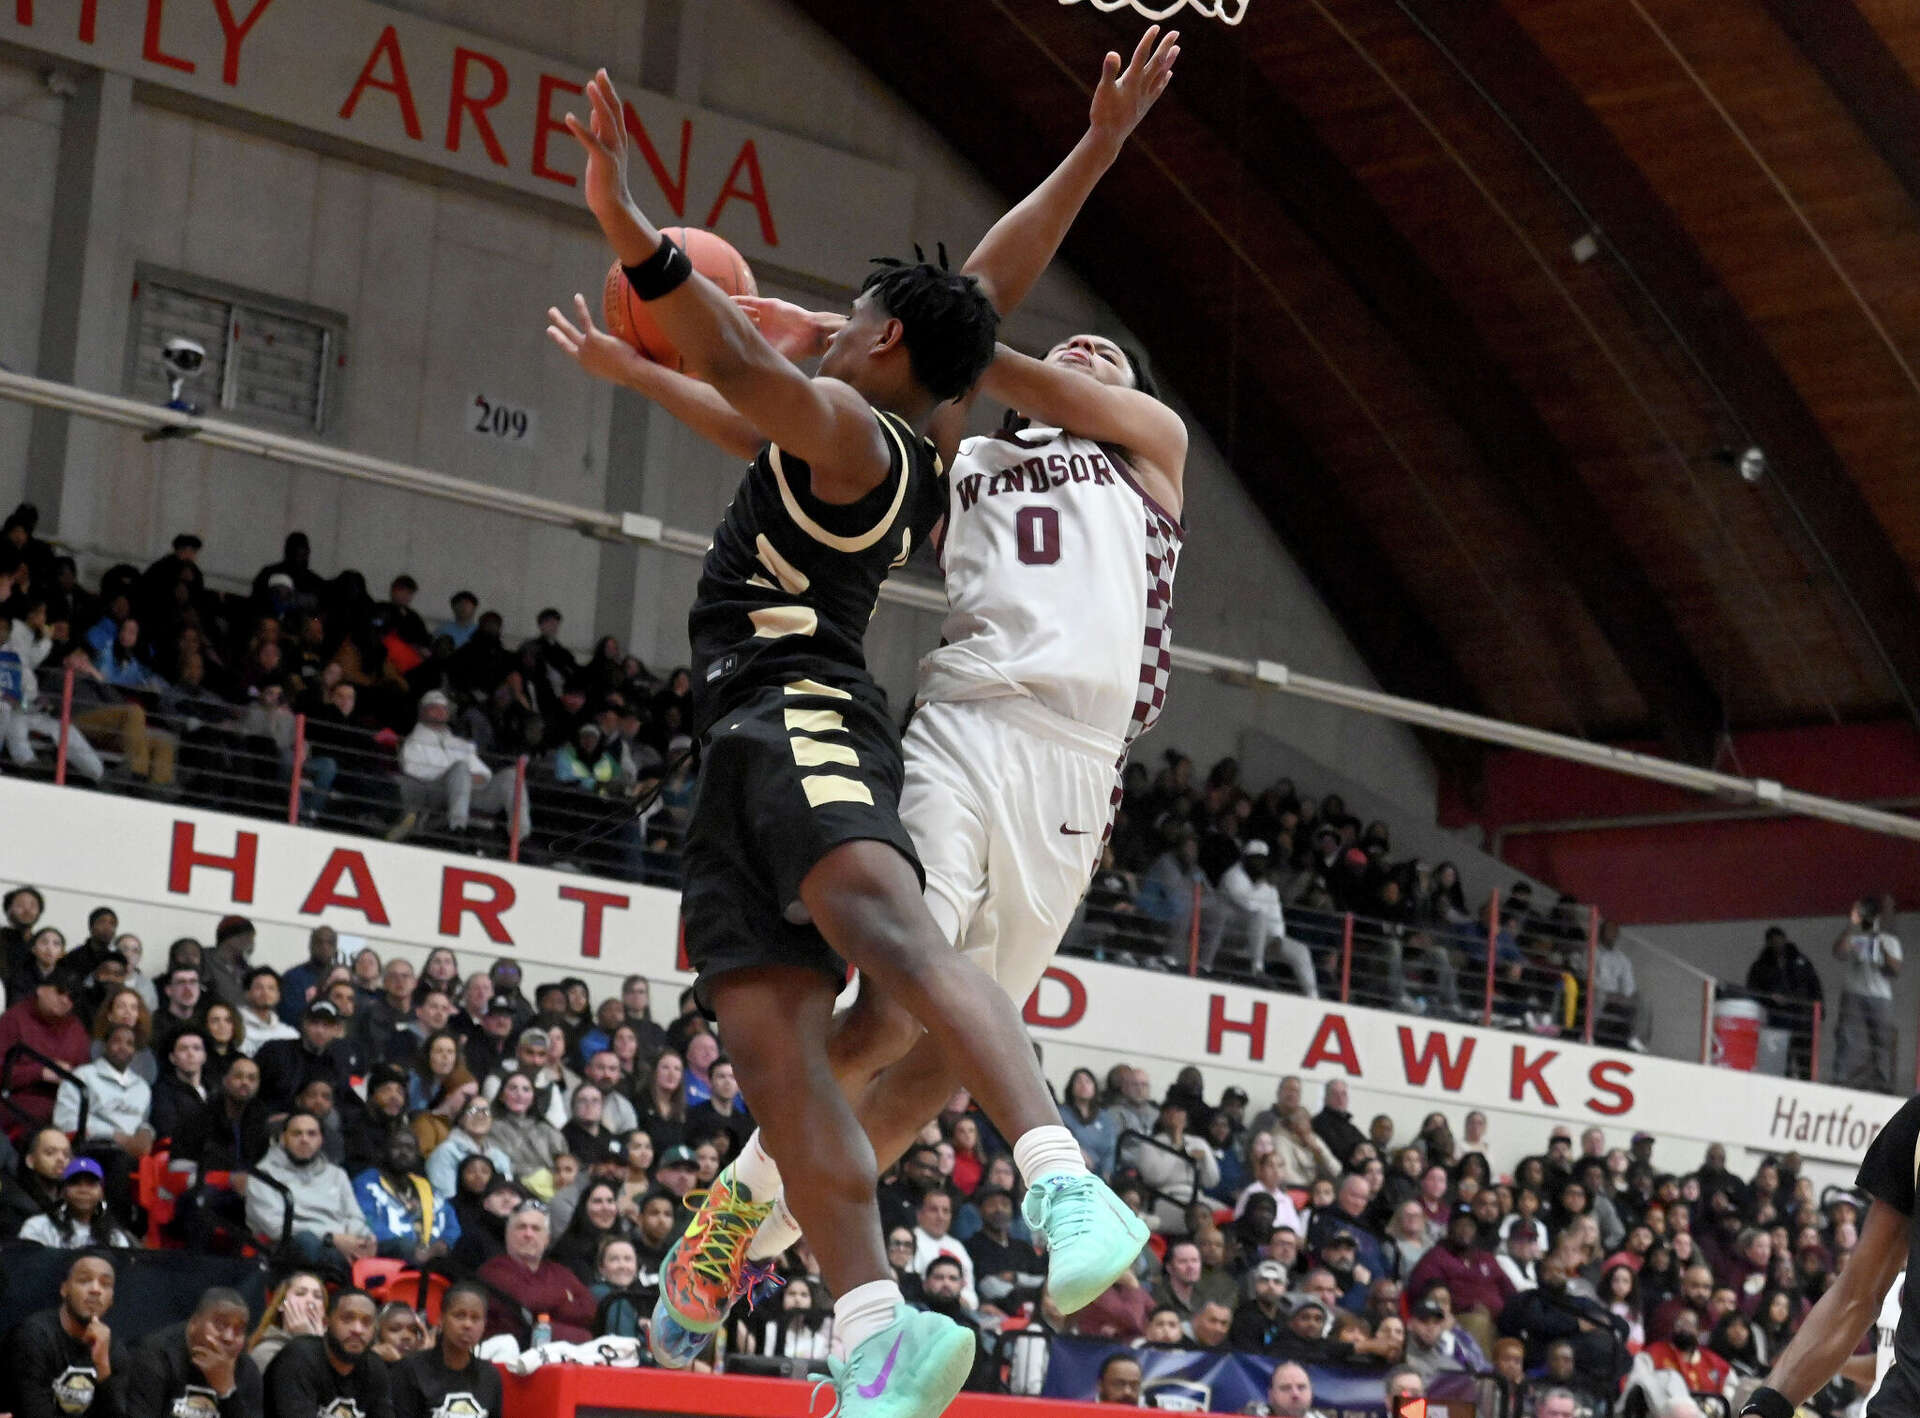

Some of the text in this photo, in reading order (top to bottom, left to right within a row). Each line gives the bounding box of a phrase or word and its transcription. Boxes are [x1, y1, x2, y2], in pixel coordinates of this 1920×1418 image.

[340, 26, 779, 247] ARENA
[474, 397, 528, 439] 209
[956, 453, 1116, 513] WINDSOR
[1015, 504, 1063, 567] 0
[169, 821, 1635, 1116] HARTD HAWKS
[1769, 1096, 1882, 1150] Hartfor
